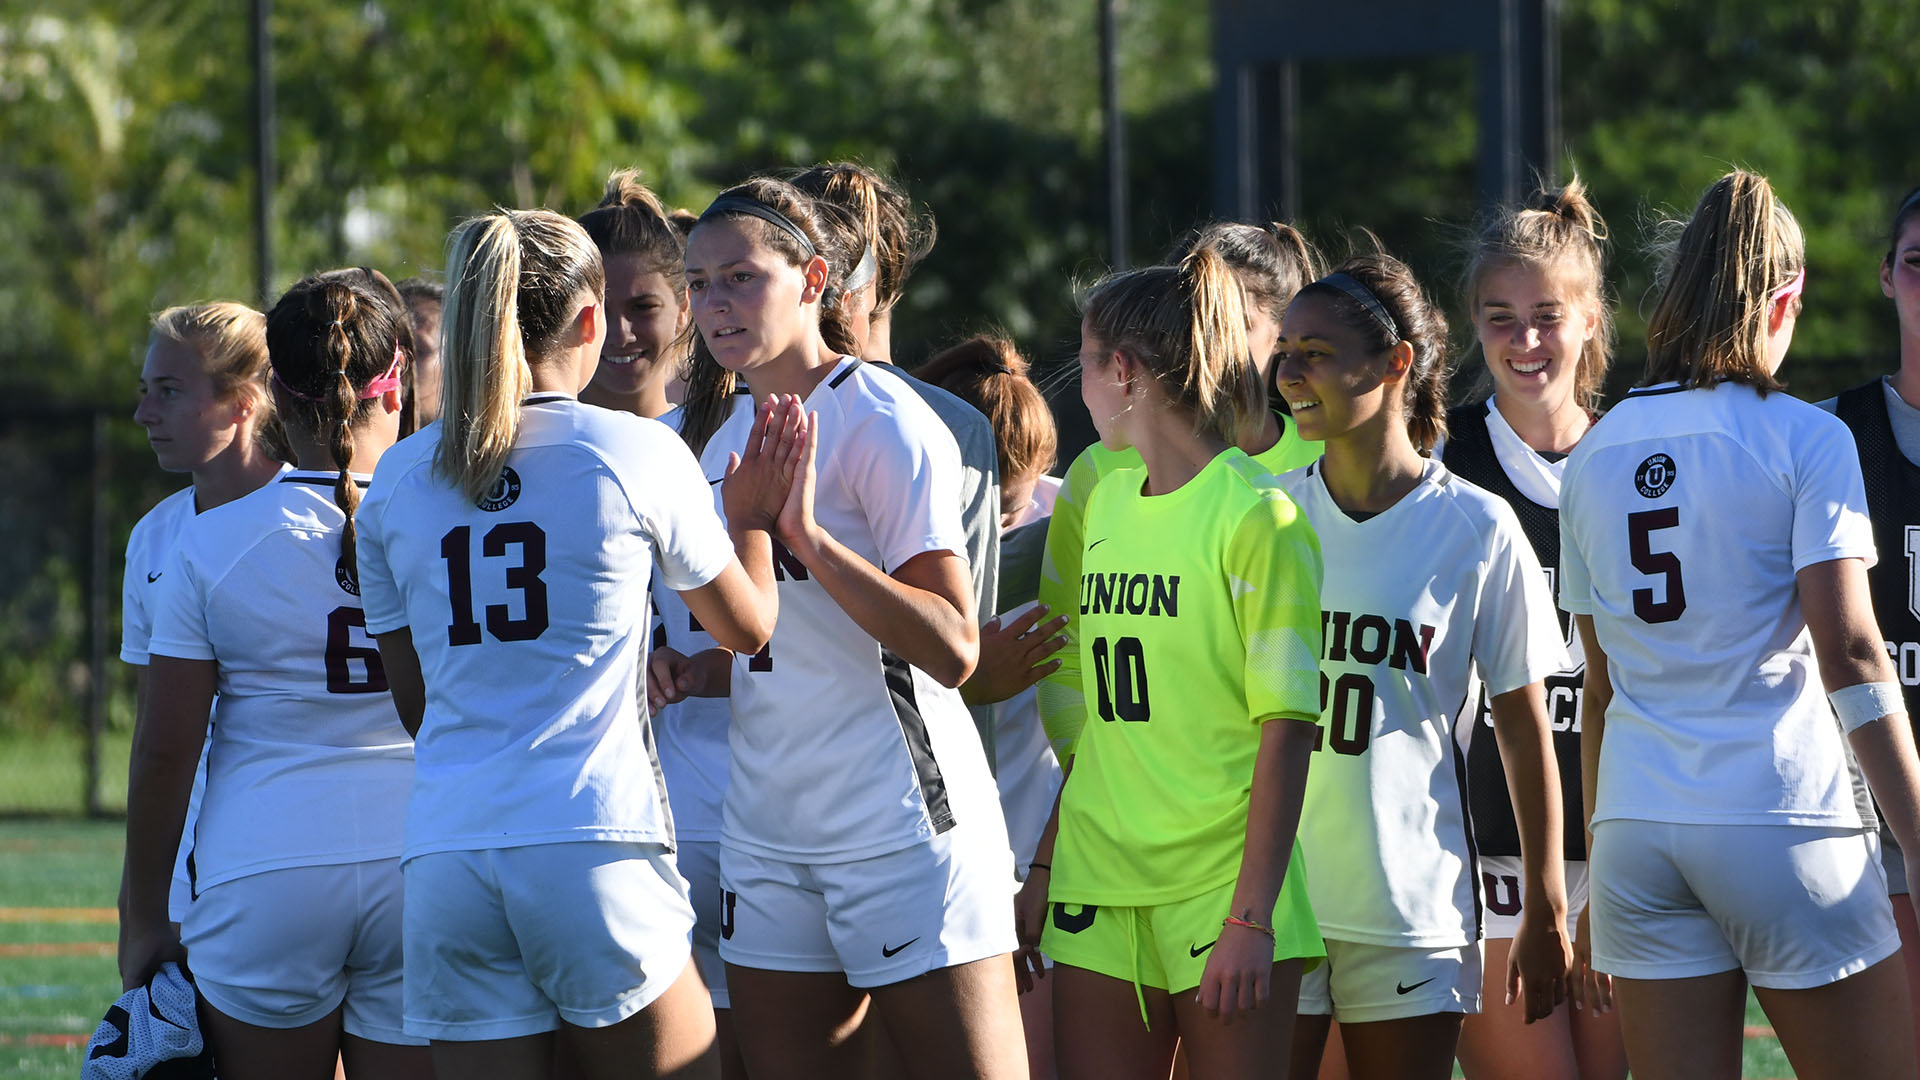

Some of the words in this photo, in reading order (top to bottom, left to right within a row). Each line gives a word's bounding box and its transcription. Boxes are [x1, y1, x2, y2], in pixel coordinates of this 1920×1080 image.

[1647, 455, 1667, 466] UNION
[1649, 467, 1664, 485] U
[476, 496, 514, 510] OLLEGE
[1640, 482, 1670, 497] COLLEGE
[441, 521, 549, 646] 13
[1628, 506, 1686, 624] 5
[1080, 573, 1180, 617] UNION
[325, 606, 389, 693] 6
[1092, 637, 1150, 722] 00
[720, 886, 737, 941] U
[1482, 872, 1523, 917] U
